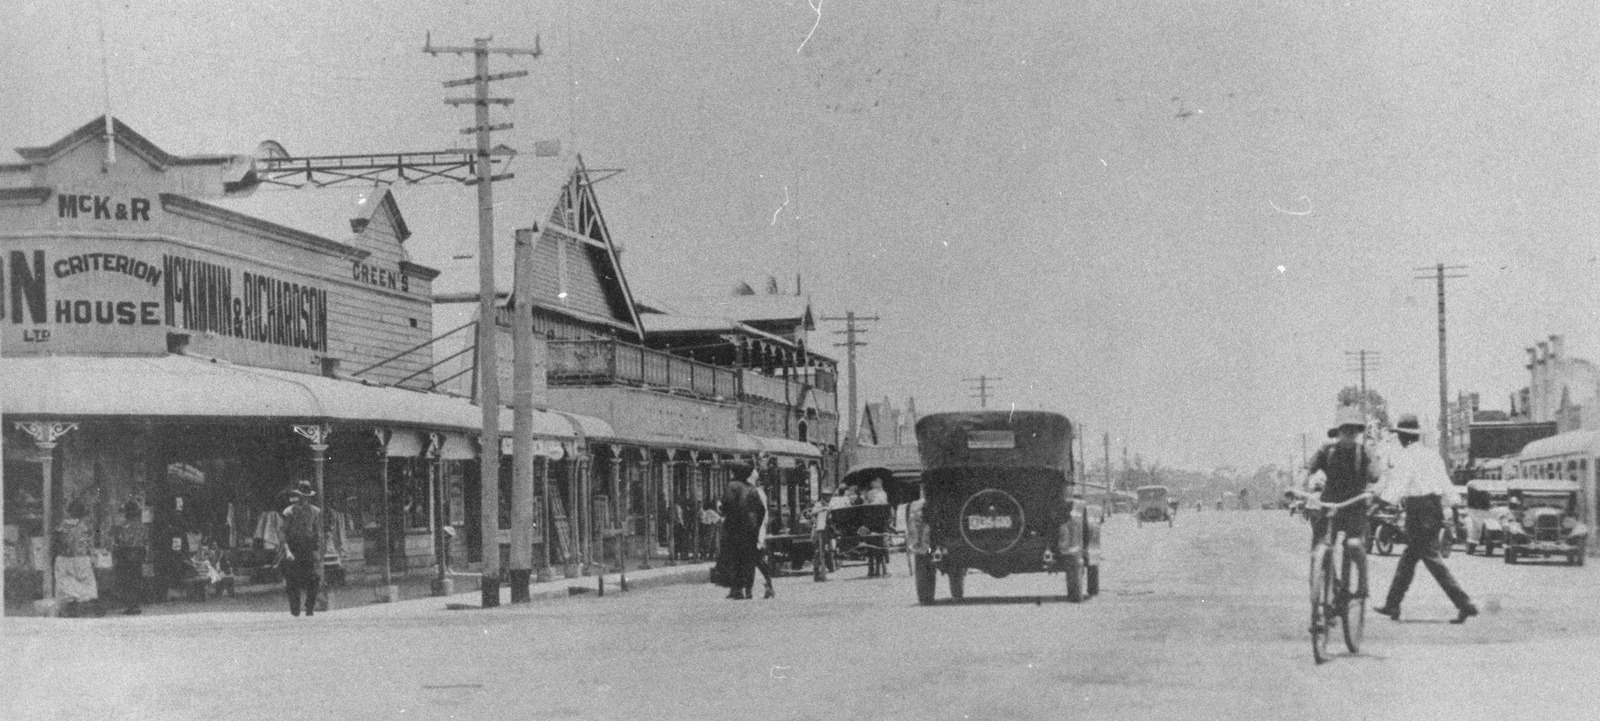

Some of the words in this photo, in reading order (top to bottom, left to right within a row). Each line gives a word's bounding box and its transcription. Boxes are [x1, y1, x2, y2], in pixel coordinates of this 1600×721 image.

[53, 253, 162, 287] CRITERION
[353, 261, 409, 292] GREEN'S
[55, 299, 161, 325] HOUSE
[243, 271, 328, 353] RICHARDSON
